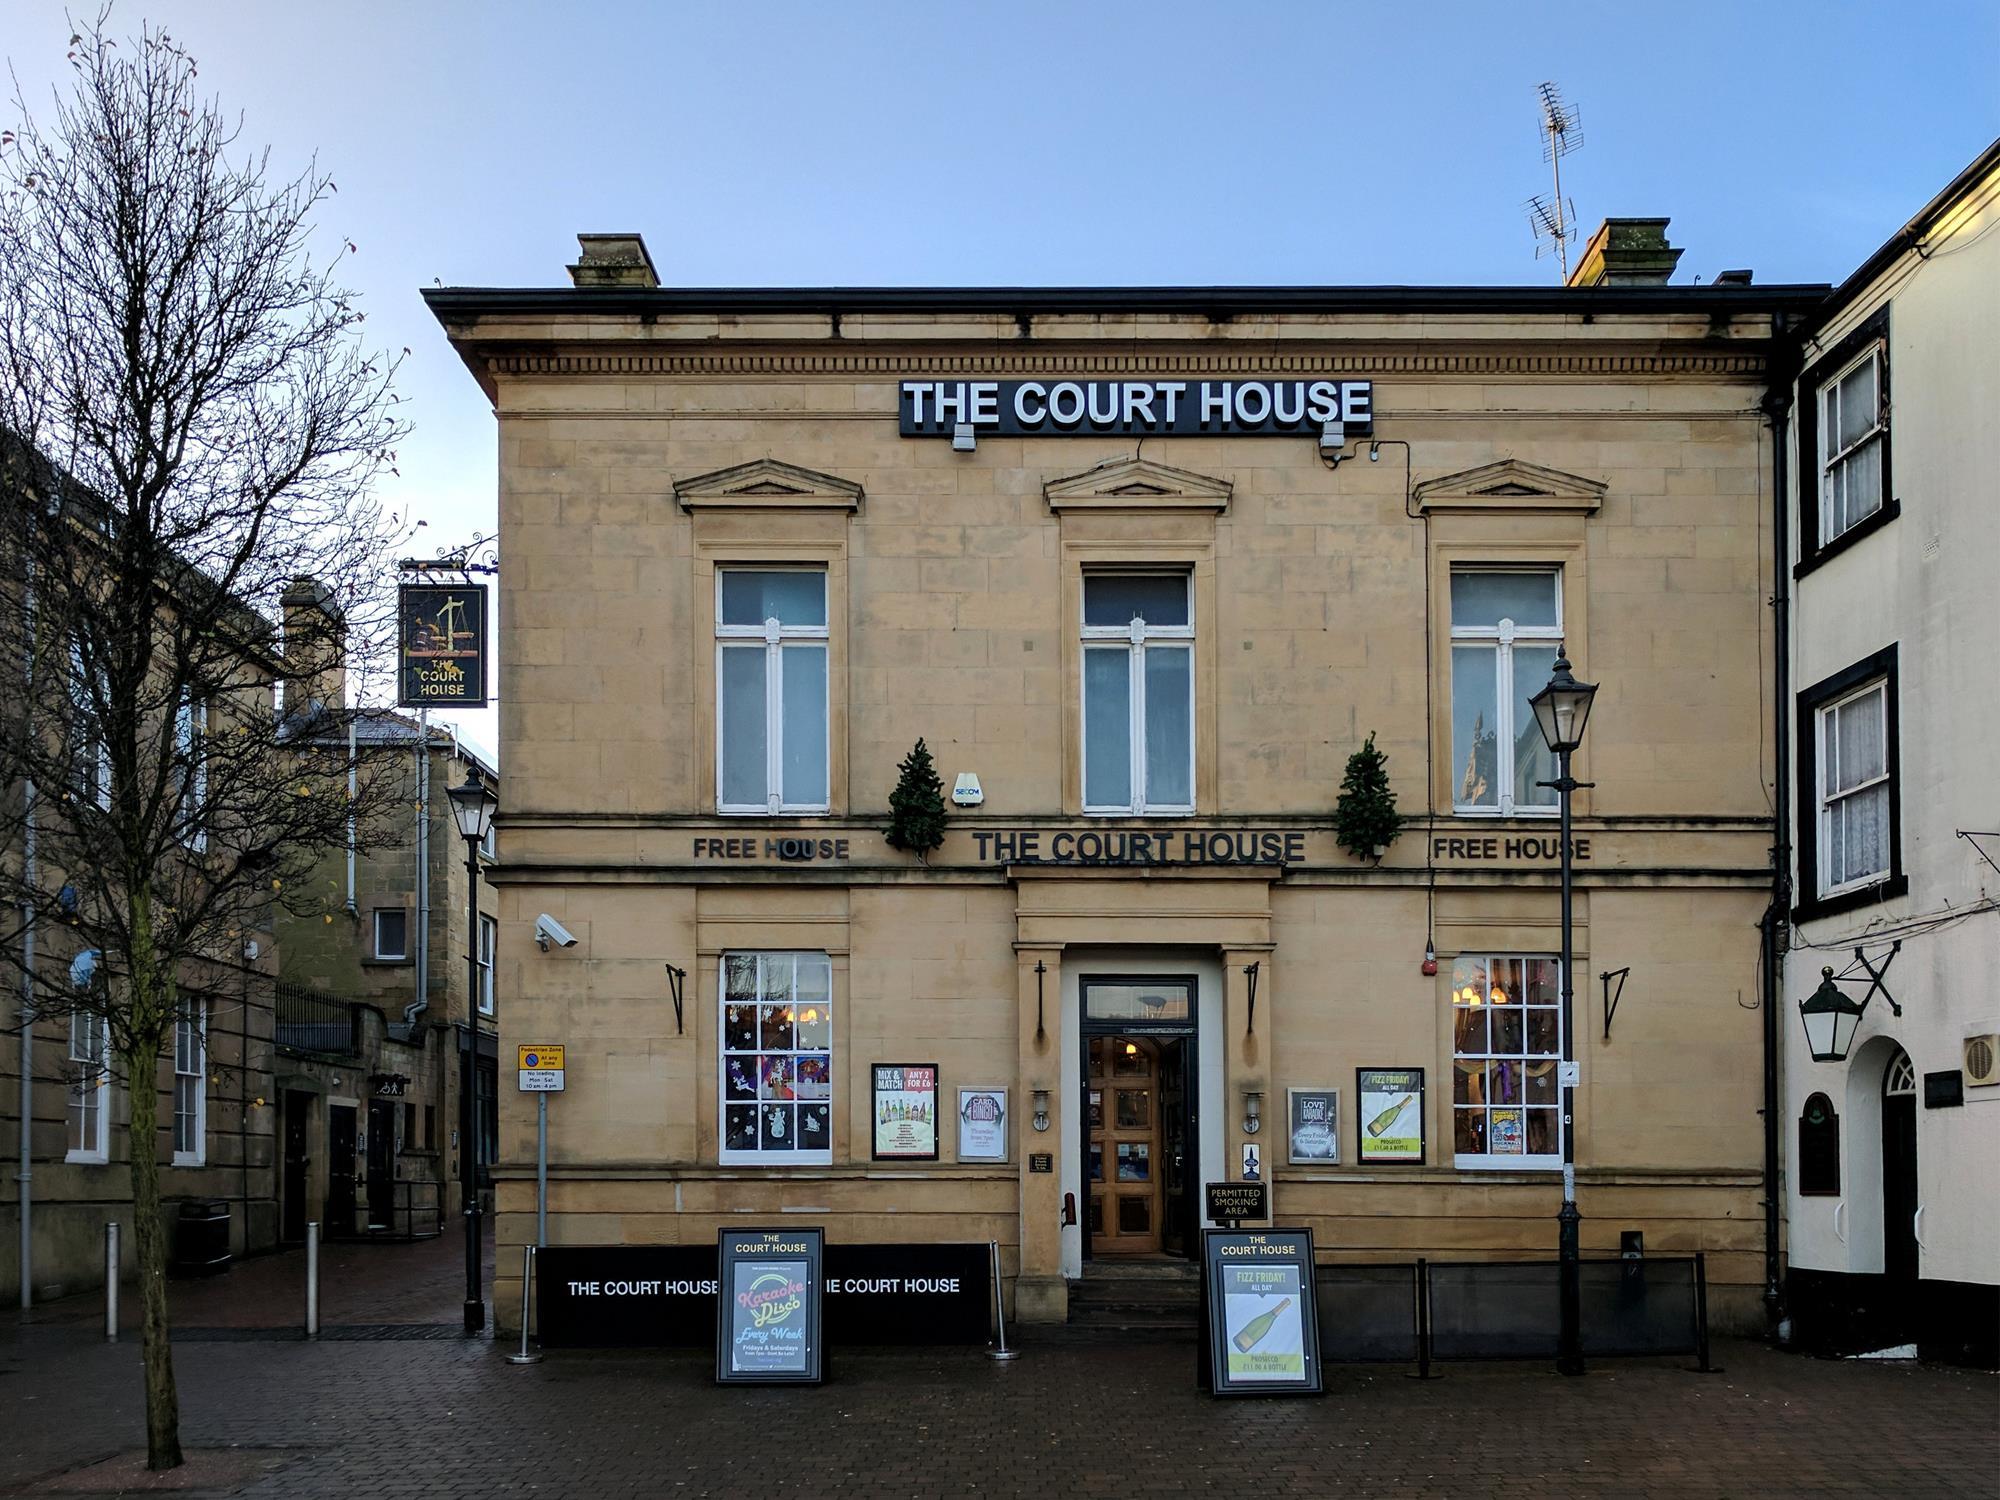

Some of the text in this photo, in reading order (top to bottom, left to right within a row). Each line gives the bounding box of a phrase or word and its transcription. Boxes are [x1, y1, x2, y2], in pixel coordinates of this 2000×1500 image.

[903, 382, 1371, 424] THE COURT HOUSE
[421, 671, 465, 681] COURT
[421, 685, 465, 695] HOUSE
[694, 838, 849, 859] FREE HOUSE
[972, 832, 1306, 862] THE COURT HOUSE
[1434, 838, 1498, 859] FREE
[878, 1070, 901, 1080] MIX &
[909, 1071, 930, 1079] ANY 2
[878, 1080, 903, 1090] MATCH
[907, 1079, 931, 1088] FOR £6
[1303, 1101, 1325, 1109] LOVE
[1565, 1115, 1571, 1123] 4
[1211, 1189, 1261, 1198] PERMITTED
[1214, 1198, 1258, 1206] SMOKING
[1224, 1207, 1249, 1215] AREA
[763, 1234, 780, 1242] THE
[1249, 1236, 1267, 1244] THE
[735, 1243, 807, 1253] COURT HOUSE
[1221, 1245, 1296, 1255] COURT HOUSE
[1237, 1271, 1286, 1283] FIZZ FRIDAY!
[568, 1280, 718, 1296] THE COURT HOUSE
[844, 1279, 900, 1294] COURT
[904, 1278, 960, 1293] HOUSE
[738, 1279, 804, 1307] Karaoke
[754, 1299, 801, 1328] Disco
[735, 1327, 803, 1344] Every Week
